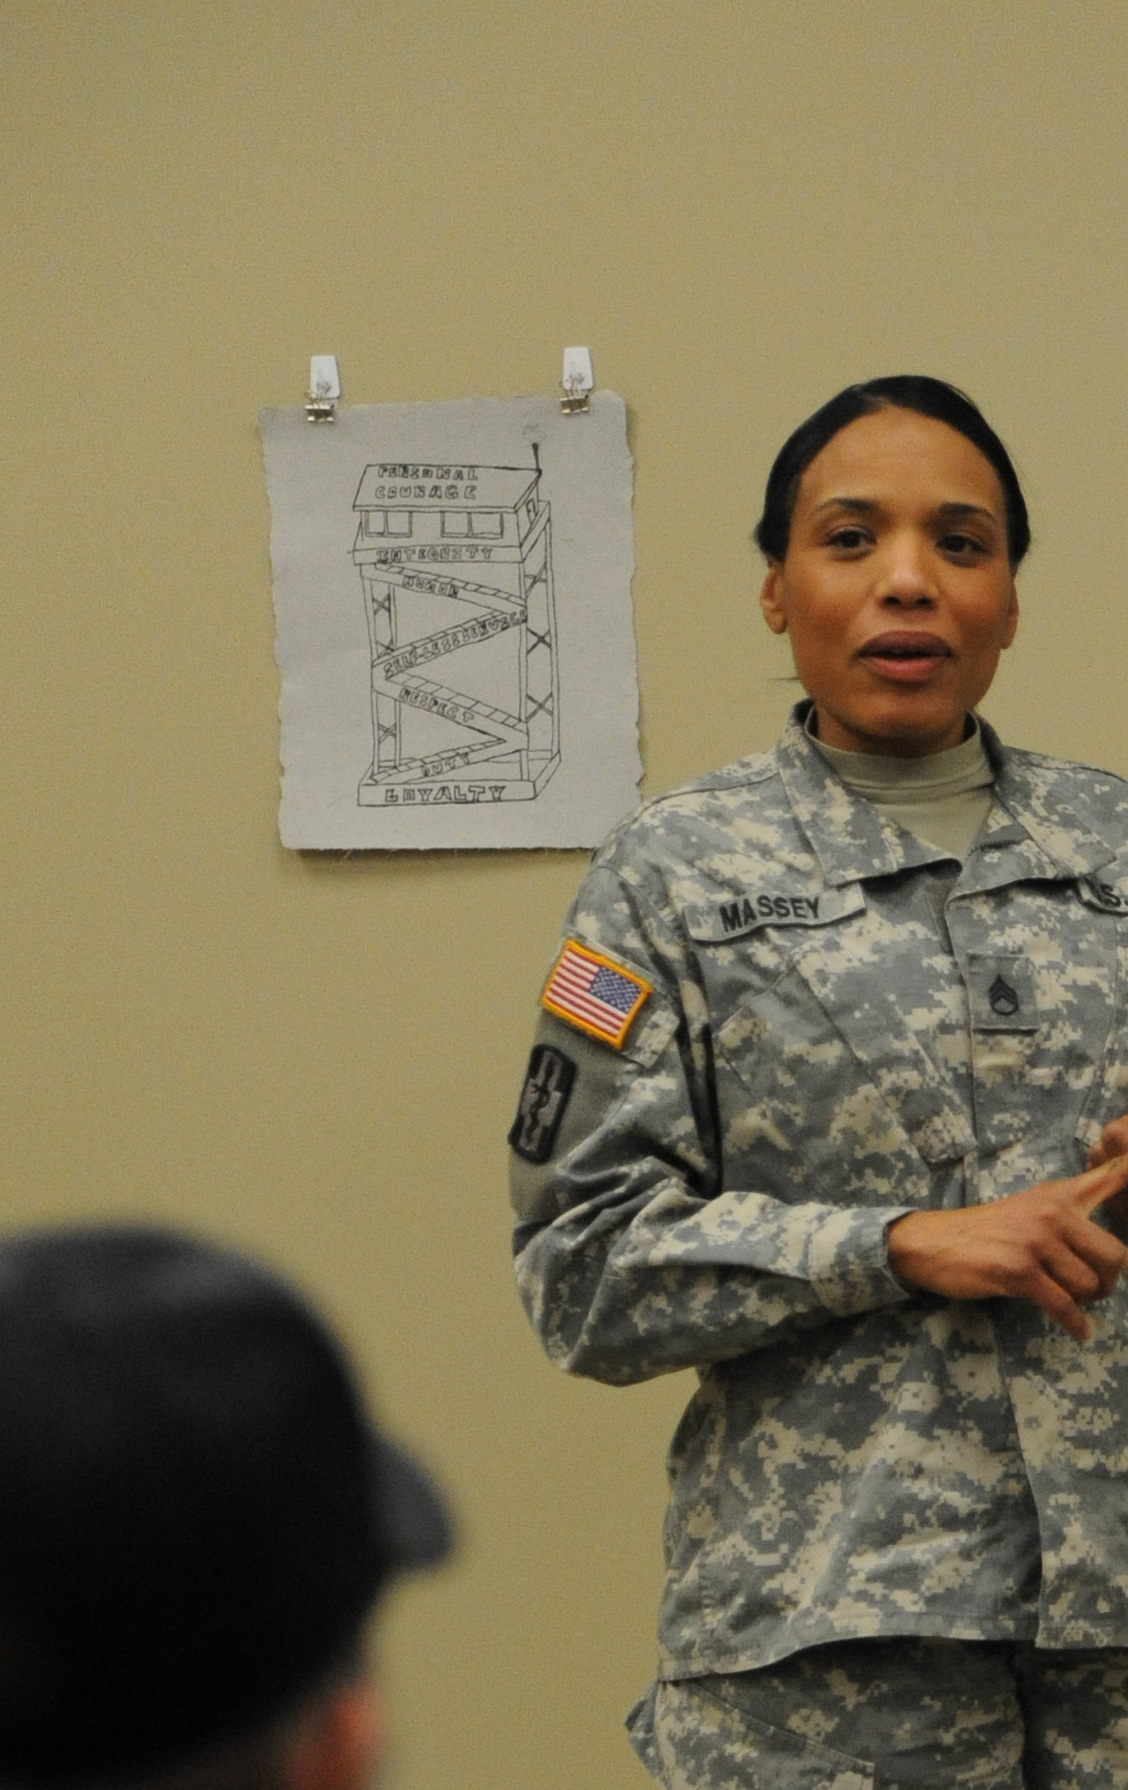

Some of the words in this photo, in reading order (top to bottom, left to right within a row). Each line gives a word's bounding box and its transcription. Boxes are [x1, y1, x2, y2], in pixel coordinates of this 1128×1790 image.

[377, 464, 479, 481] PERSONAL
[374, 485, 477, 500] COURAGE
[376, 546, 494, 563] INTEGRITY
[402, 575, 459, 598] HONOR
[399, 687, 475, 723] RESPECT
[421, 752, 472, 778] DUTY
[384, 785, 507, 803] LOYALTY
[718, 895, 821, 933] MASSEY
